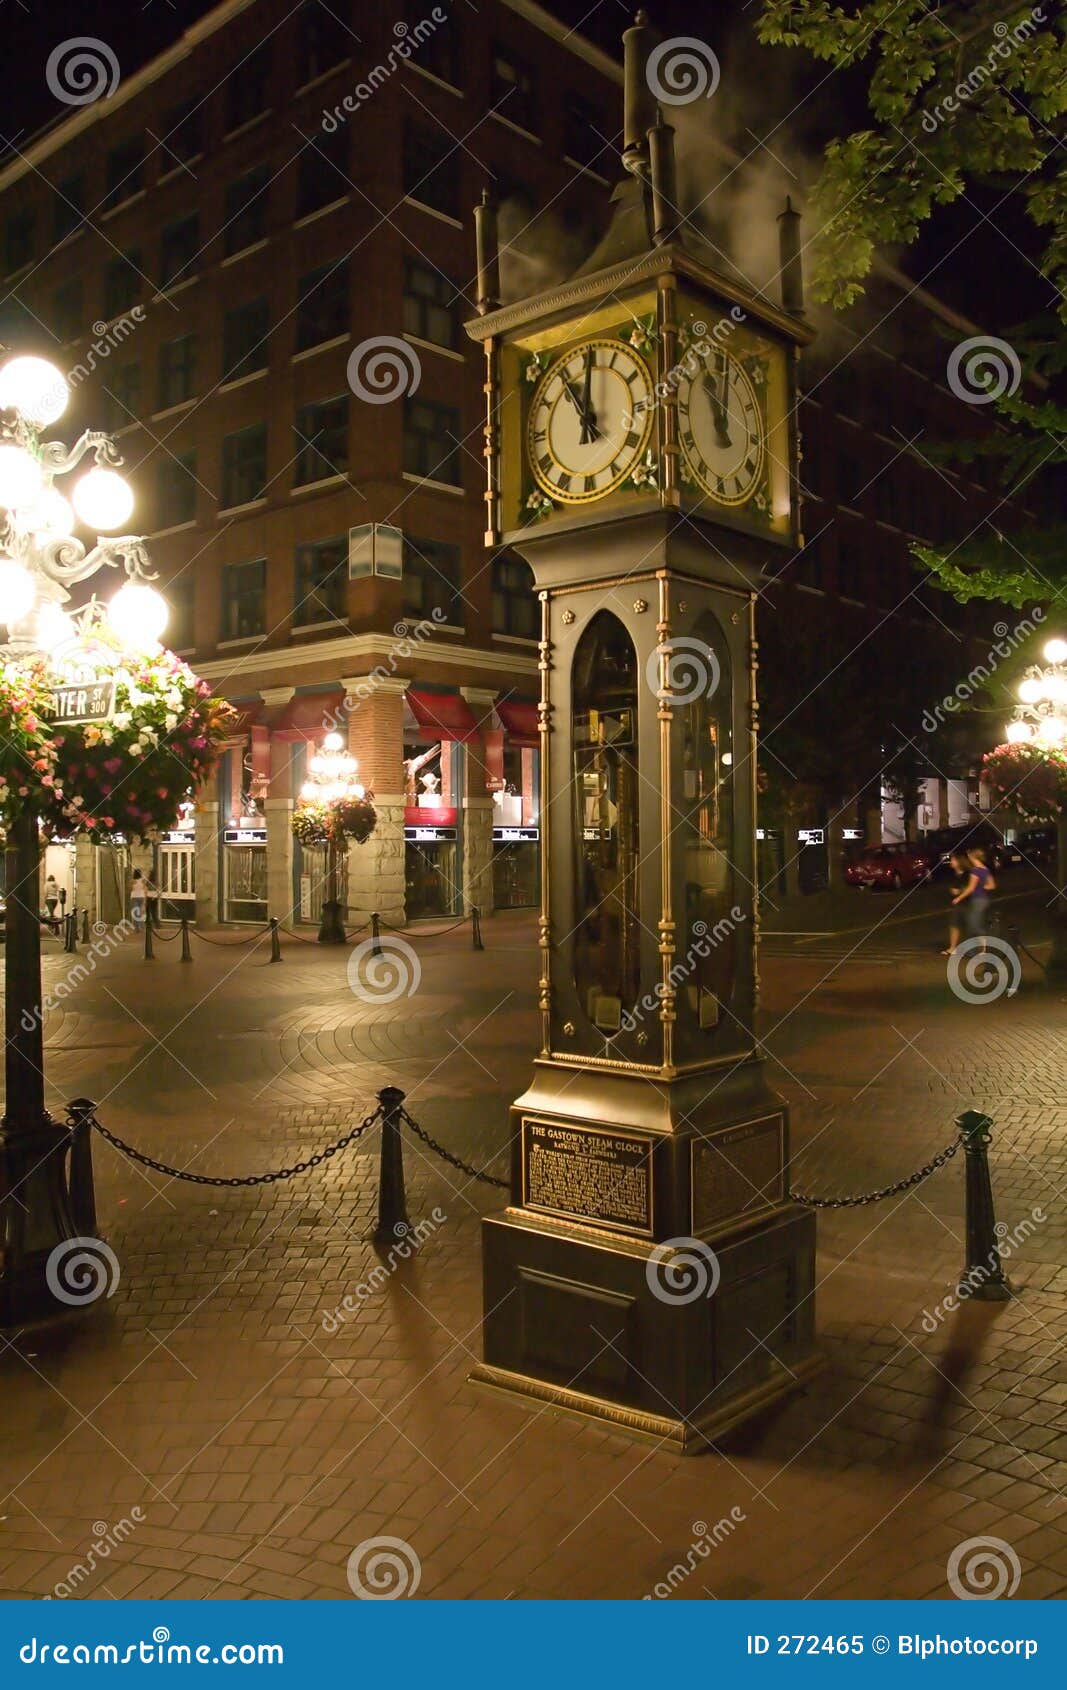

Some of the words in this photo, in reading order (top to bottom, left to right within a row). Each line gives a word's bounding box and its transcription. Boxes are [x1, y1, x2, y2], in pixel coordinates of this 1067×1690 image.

[50, 690, 87, 718] ATER
[90, 701, 106, 713] 300
[531, 1126, 546, 1137] THE
[547, 1129, 586, 1144] GASTOWN
[587, 1137, 613, 1149] STEAM
[615, 1142, 644, 1154] CLOCK
